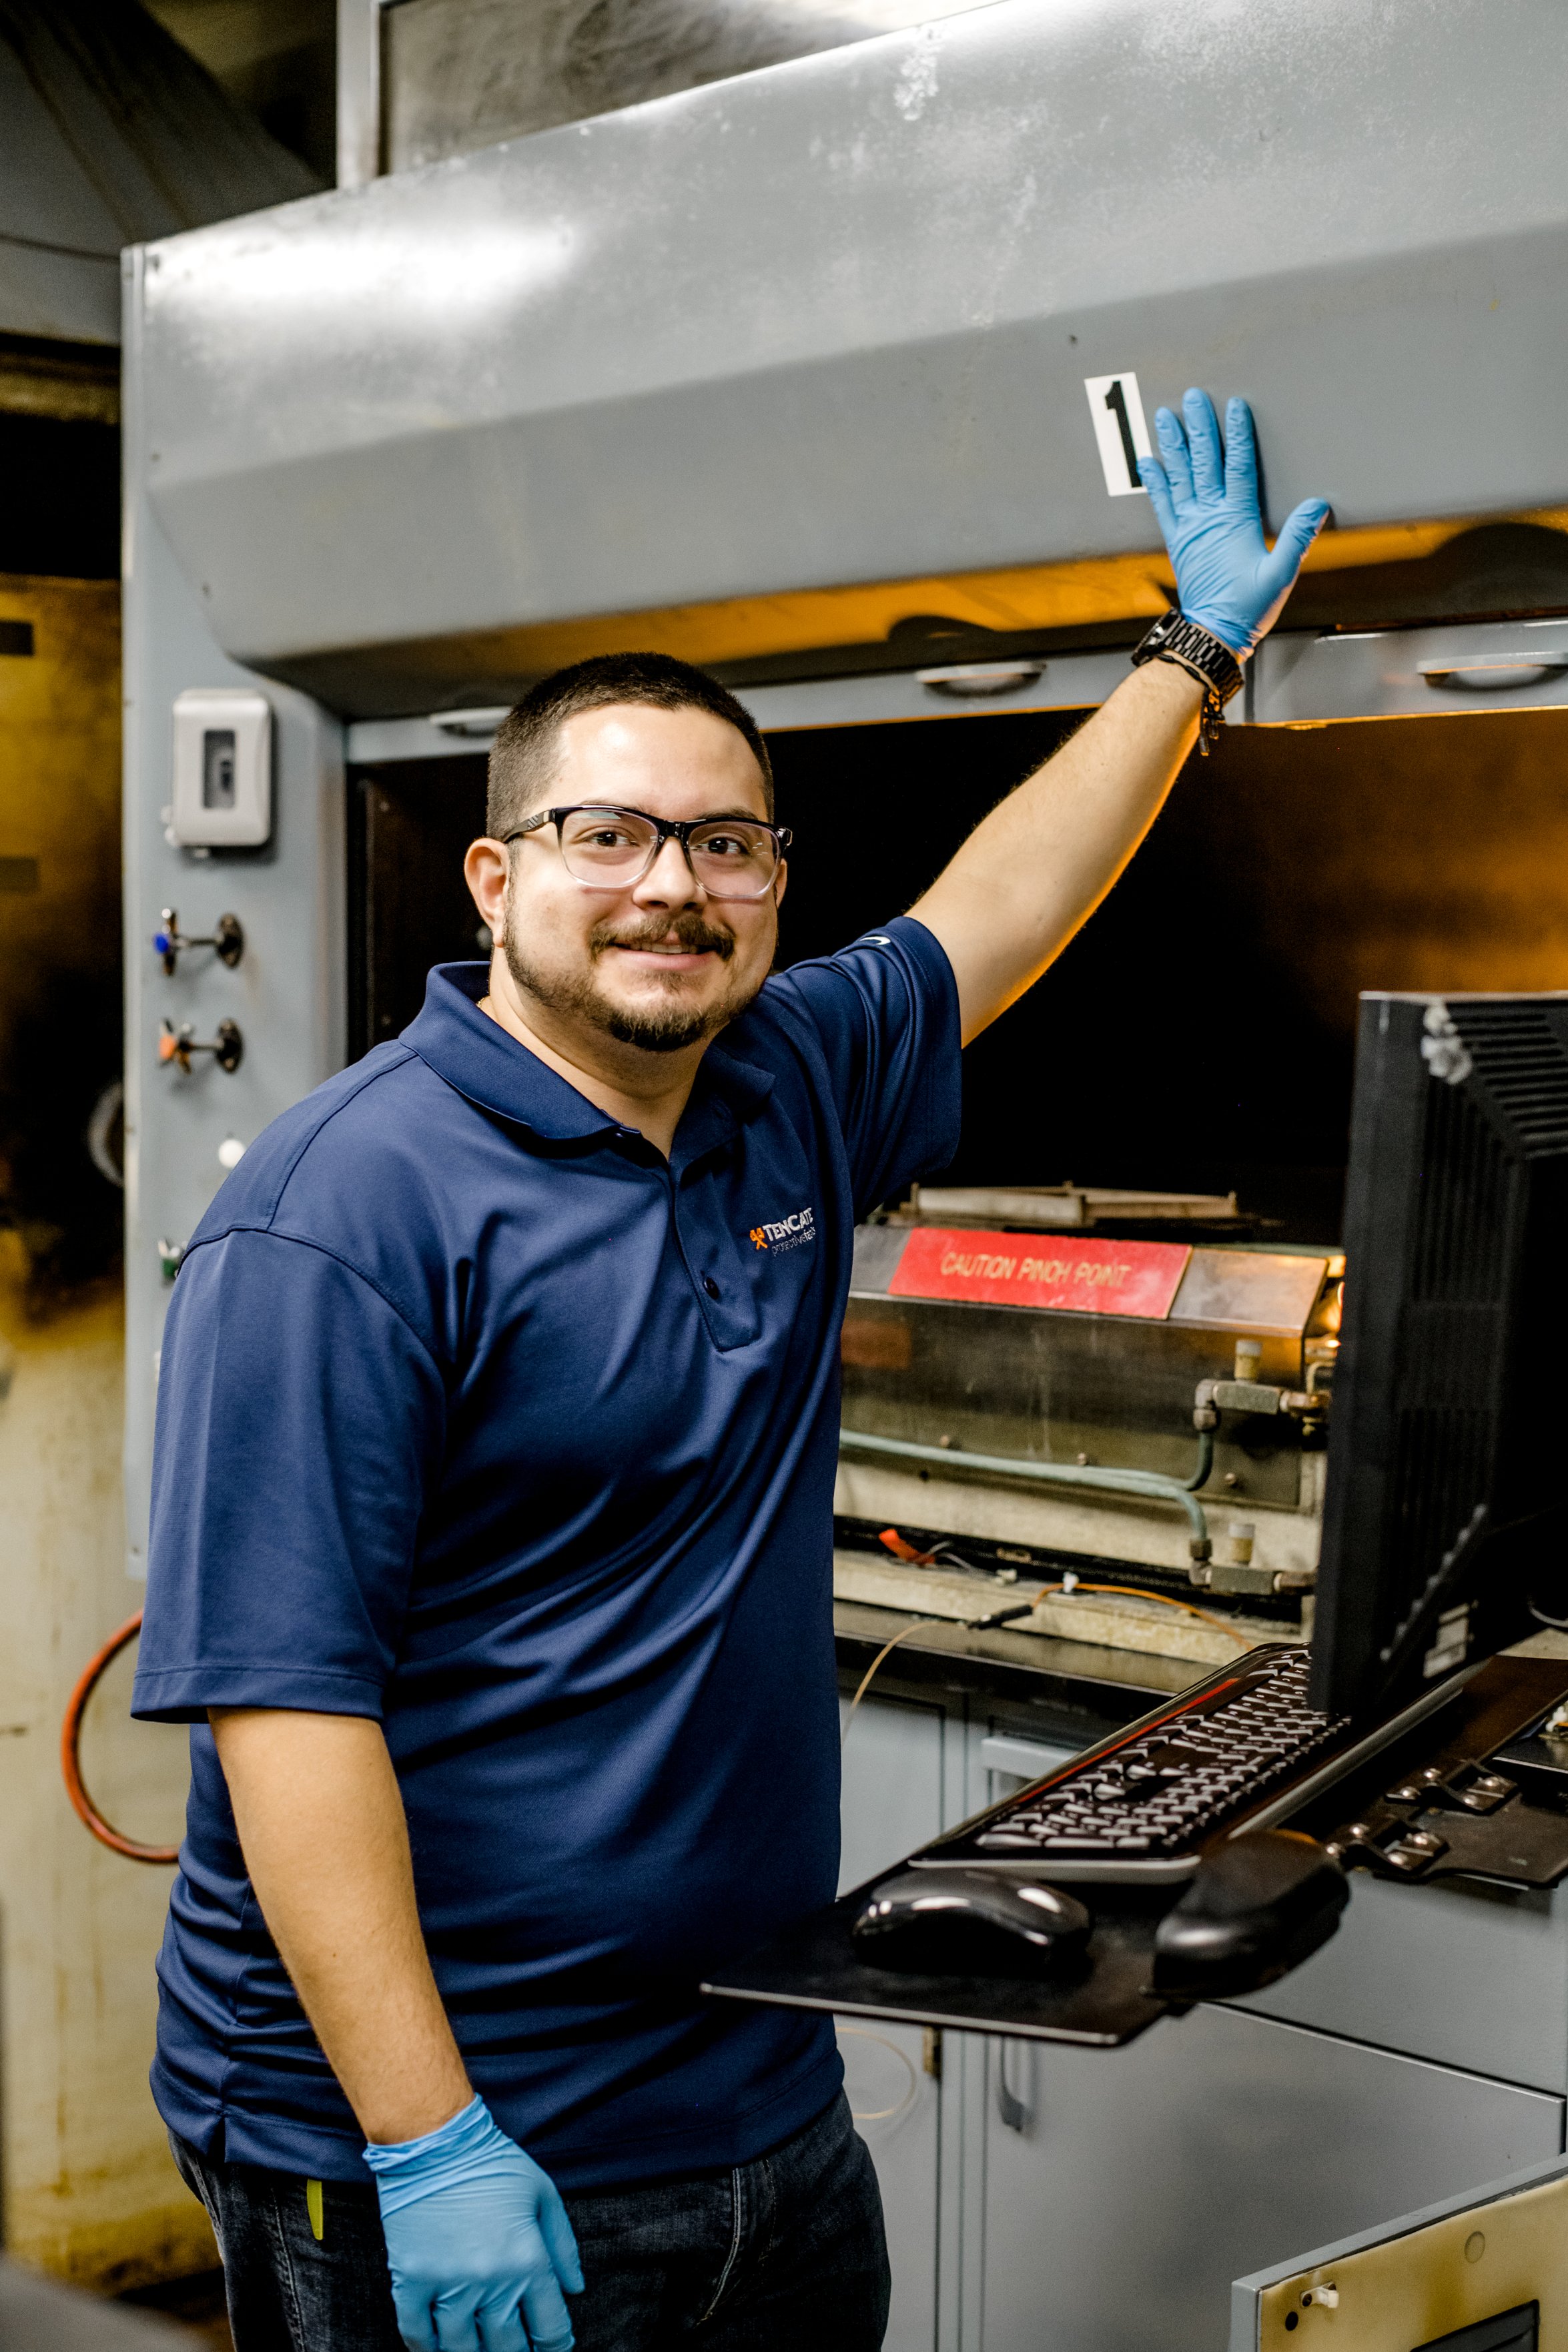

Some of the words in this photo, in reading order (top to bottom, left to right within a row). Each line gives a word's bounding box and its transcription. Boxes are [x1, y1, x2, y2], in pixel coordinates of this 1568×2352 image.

[1105, 380, 1143, 488] 1
[940, 1252, 1017, 1279] CAUTION
[1017, 1257, 1072, 1284] PINCH
[1074, 1261, 1132, 1288] POINT
